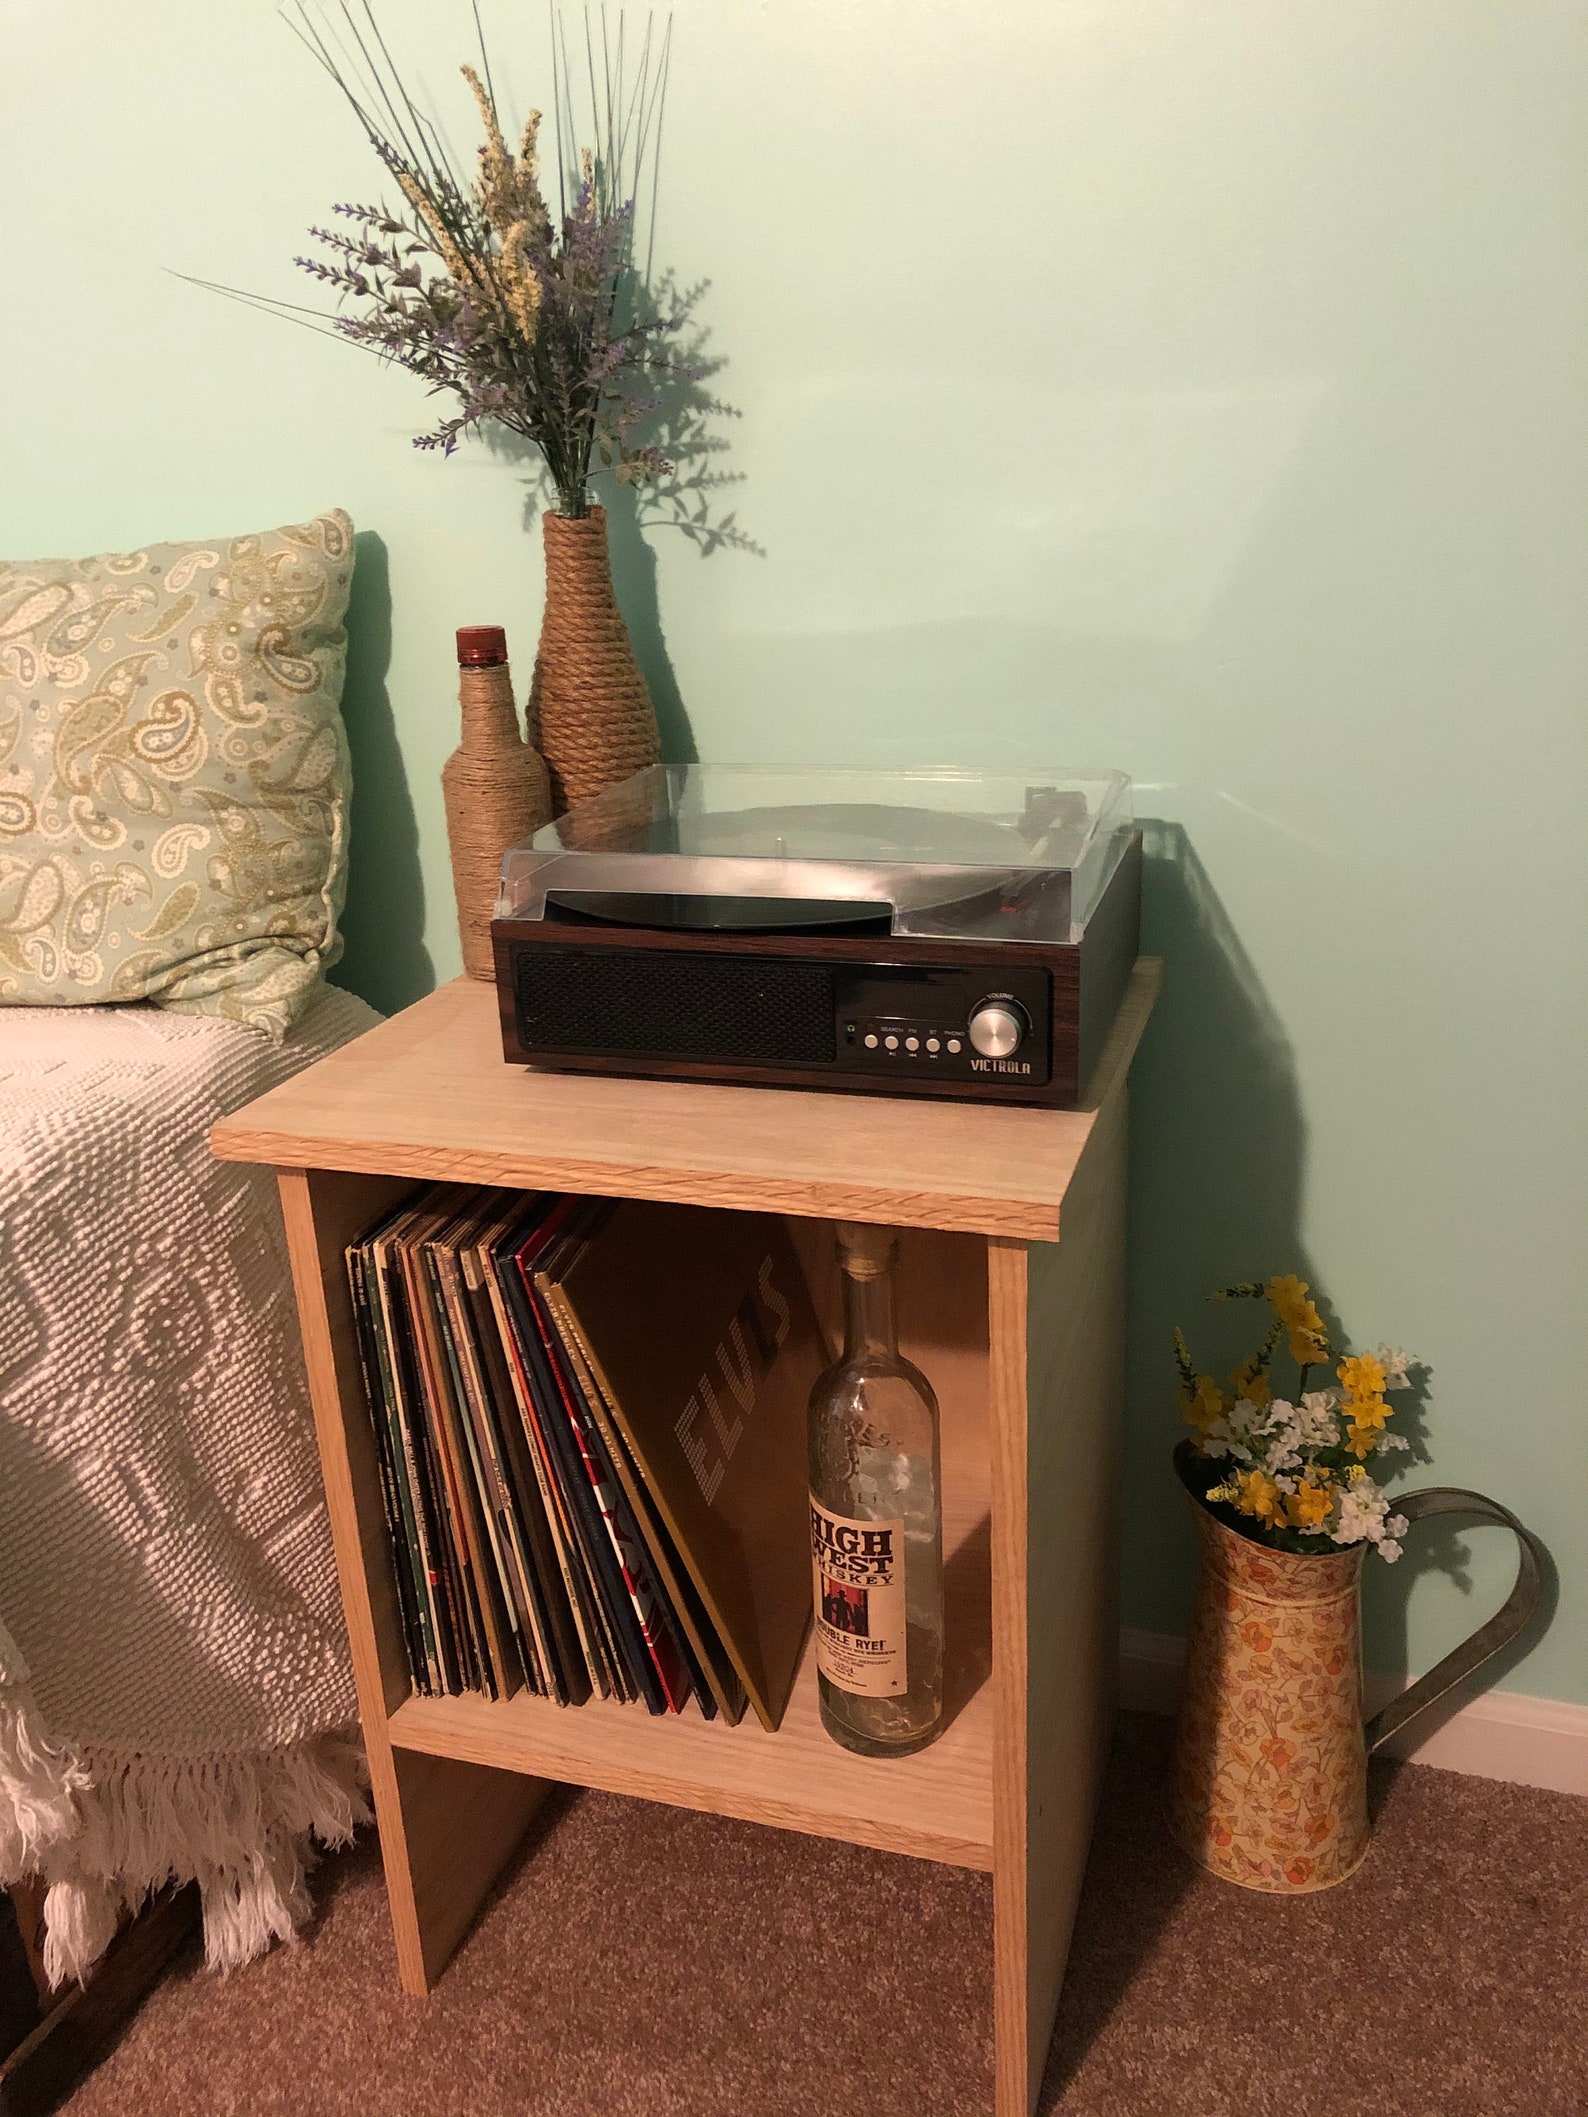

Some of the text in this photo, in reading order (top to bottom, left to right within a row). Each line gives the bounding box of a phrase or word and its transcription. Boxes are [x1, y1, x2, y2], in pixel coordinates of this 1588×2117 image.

[986, 992, 1014, 1000] VOLUME
[970, 1059, 1031, 1075] VICTROLA
[674, 1254, 791, 1506] ELVIS
[811, 1503, 893, 1556] HIGH
[812, 1536, 893, 1574] WEST
[817, 1556, 893, 1585] HISKEY
